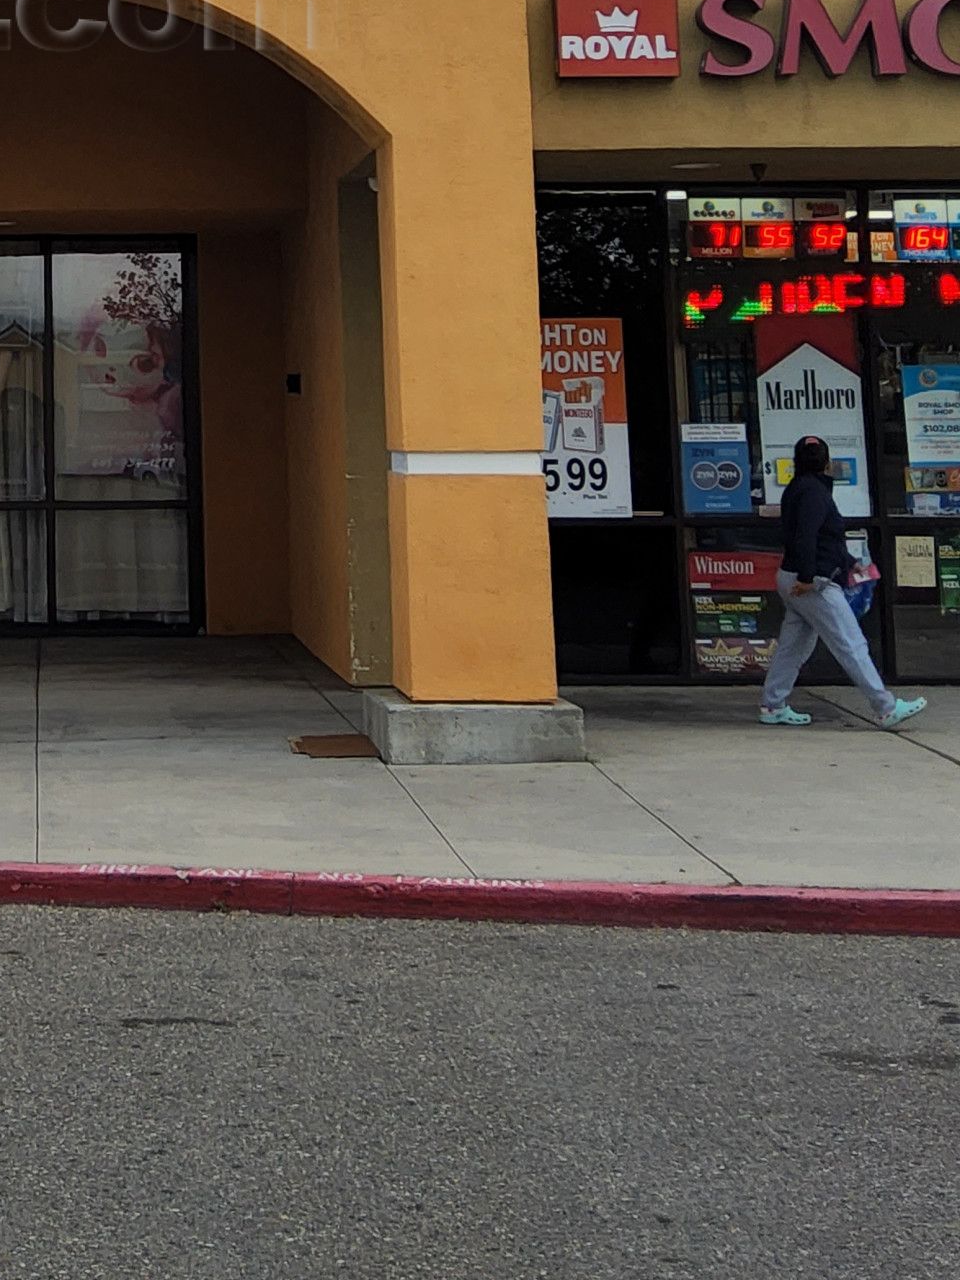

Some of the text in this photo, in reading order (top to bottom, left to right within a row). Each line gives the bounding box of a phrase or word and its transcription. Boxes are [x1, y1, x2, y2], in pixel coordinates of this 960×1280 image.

[561, 34, 677, 60] ROYAL
[709, 225, 741, 247] 71
[761, 226, 792, 247] 55
[813, 226, 845, 248] 52
[909, 227, 947, 249] 164
[578, 328, 607, 346] ON
[764, 369, 856, 411] Marlboro
[694, 556, 755, 575] Winston
[696, 603, 762, 612] NON-MENTHOL
[701, 655, 746, 663] MAVERICK
